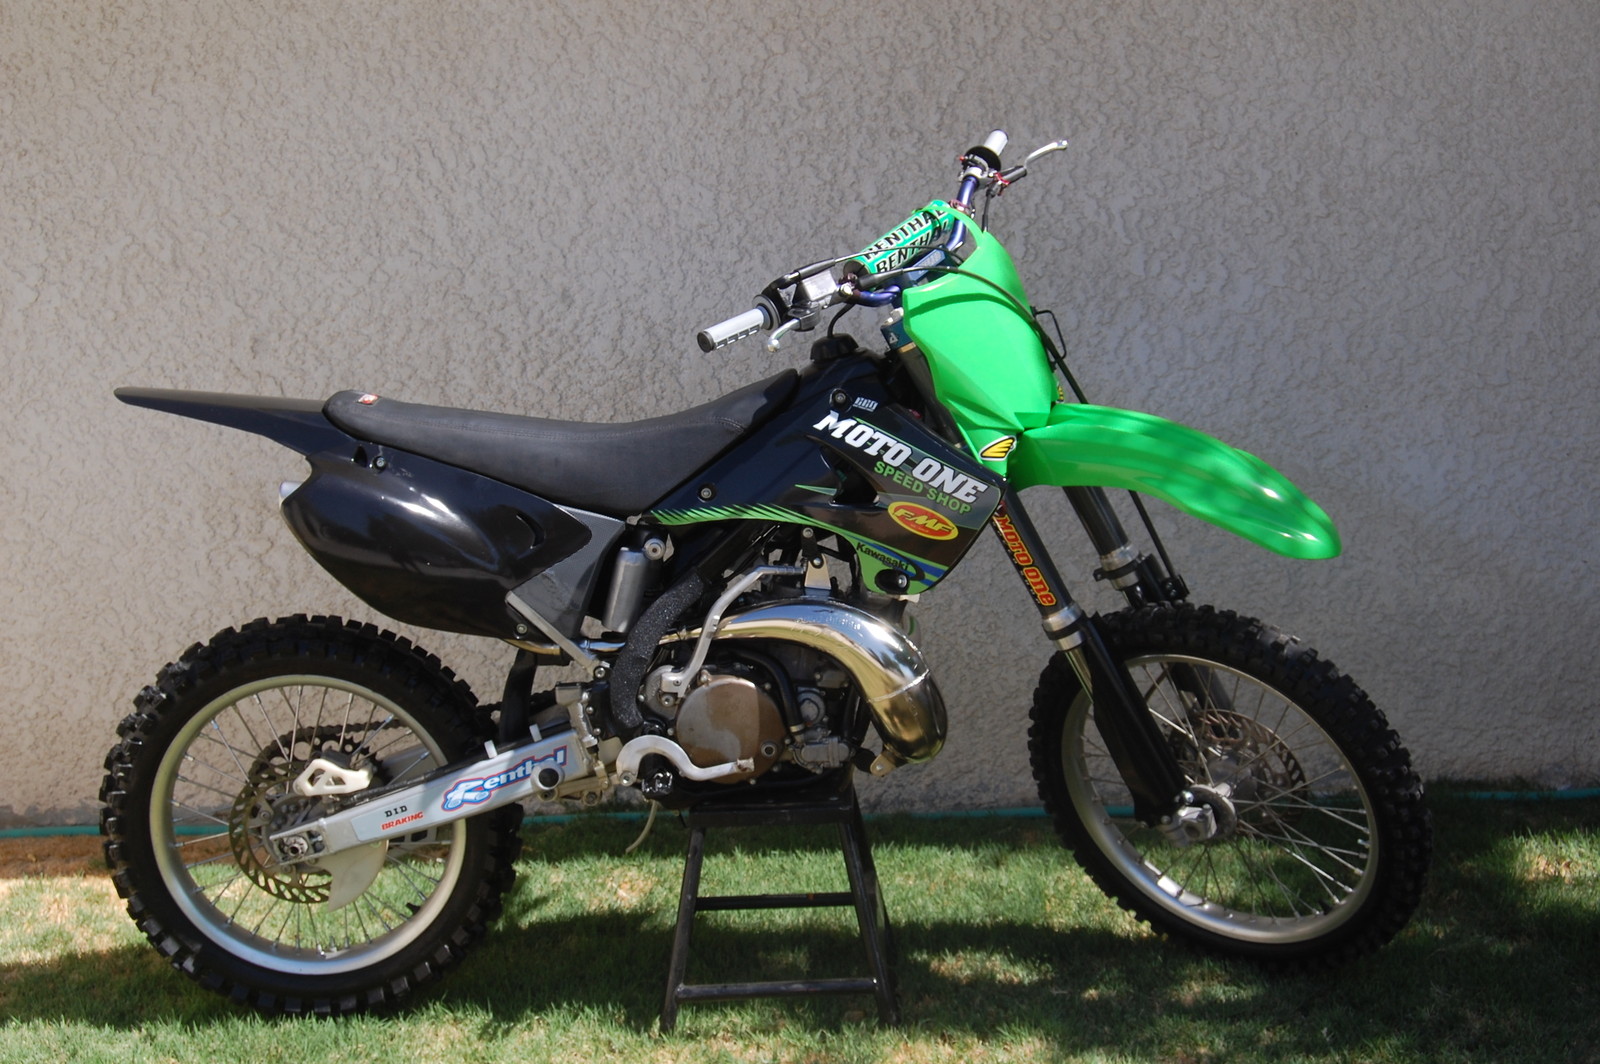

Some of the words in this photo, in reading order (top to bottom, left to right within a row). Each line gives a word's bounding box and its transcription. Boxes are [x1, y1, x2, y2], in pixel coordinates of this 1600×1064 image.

[813, 410, 911, 467] MOTO
[912, 457, 988, 503] ONE
[874, 461, 923, 493] SPEED
[926, 488, 971, 514] SHOP
[893, 508, 955, 532] FMF
[993, 514, 1033, 566] MOTO
[857, 542, 908, 570] Kawasaki
[442, 746, 567, 811] Renthl
[381, 811, 424, 830] BRAKING
